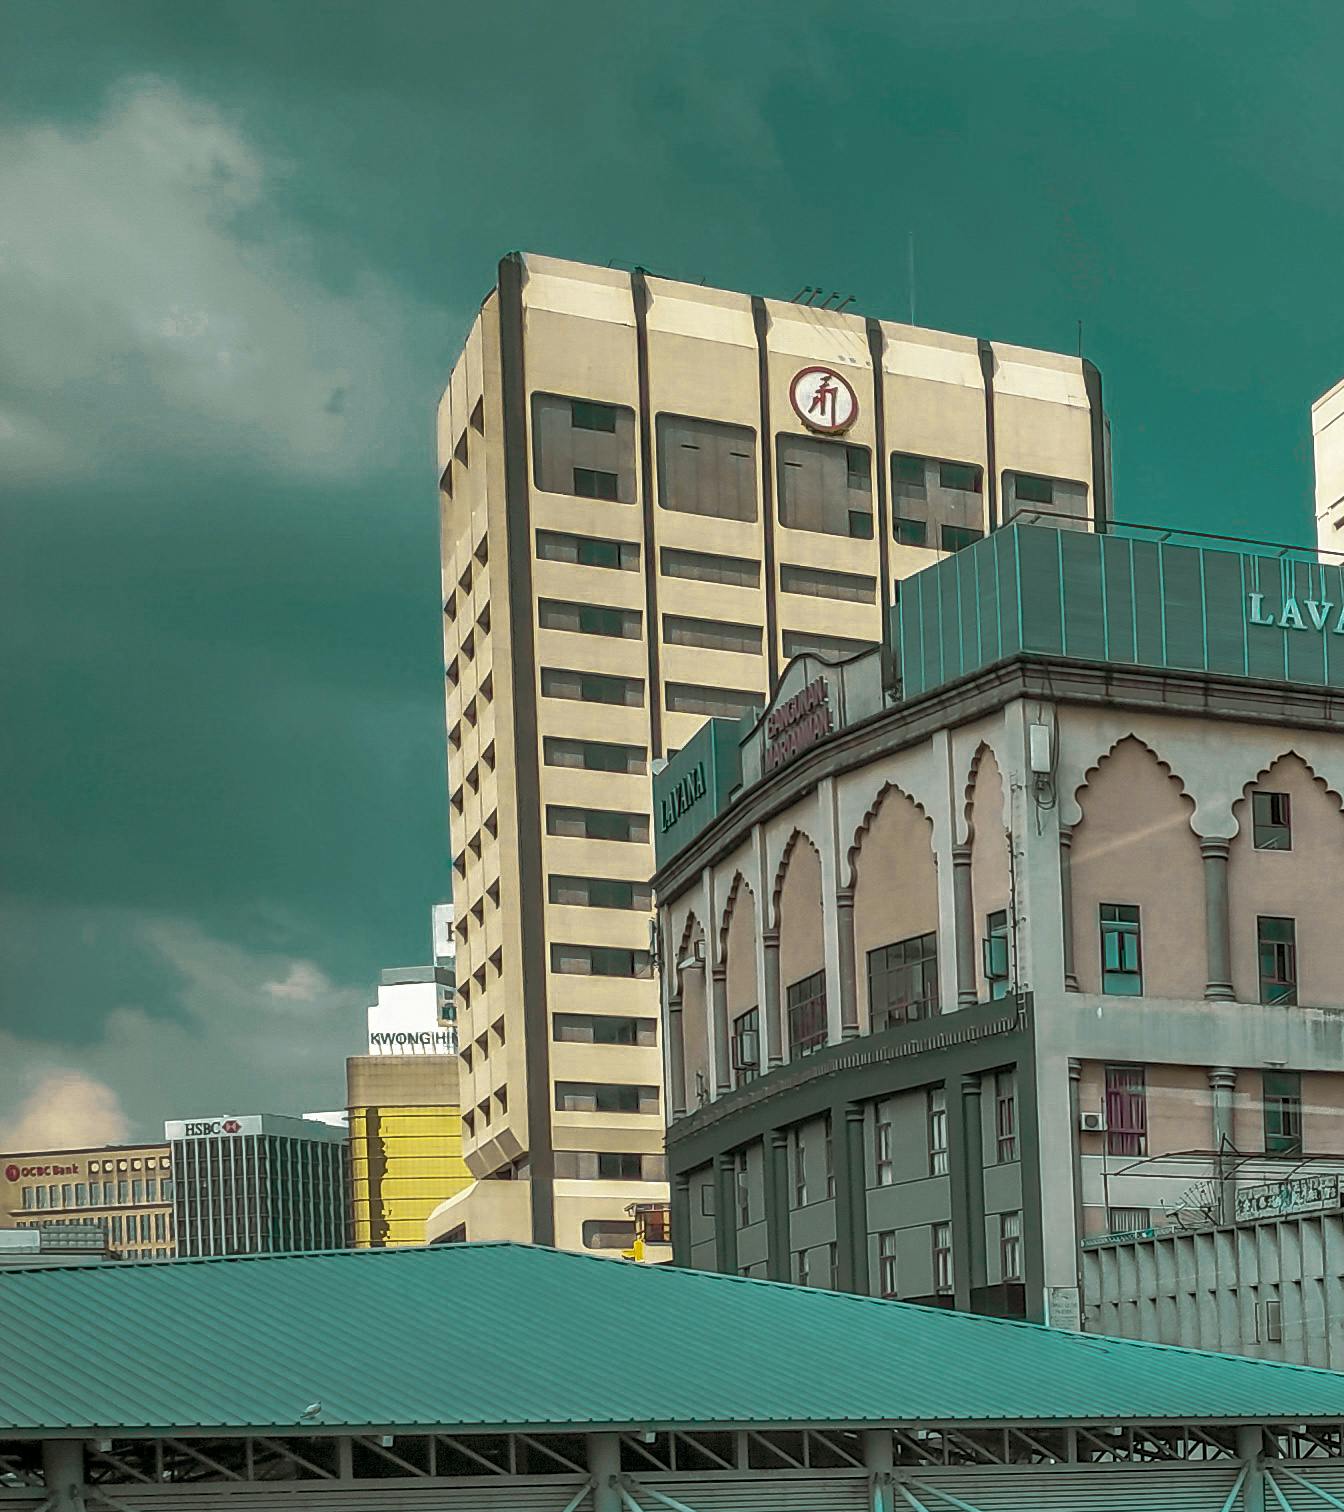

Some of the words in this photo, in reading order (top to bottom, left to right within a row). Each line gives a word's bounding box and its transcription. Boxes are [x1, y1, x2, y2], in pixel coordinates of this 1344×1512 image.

[768, 676, 830, 740] BANGUNAN
[661, 761, 707, 834] LAVANA
[370, 1032, 431, 1046] KWONG
[185, 1121, 221, 1137] HSBC
[21, 1166, 51, 1178] OCBC
[52, 1163, 79, 1176] Bank
